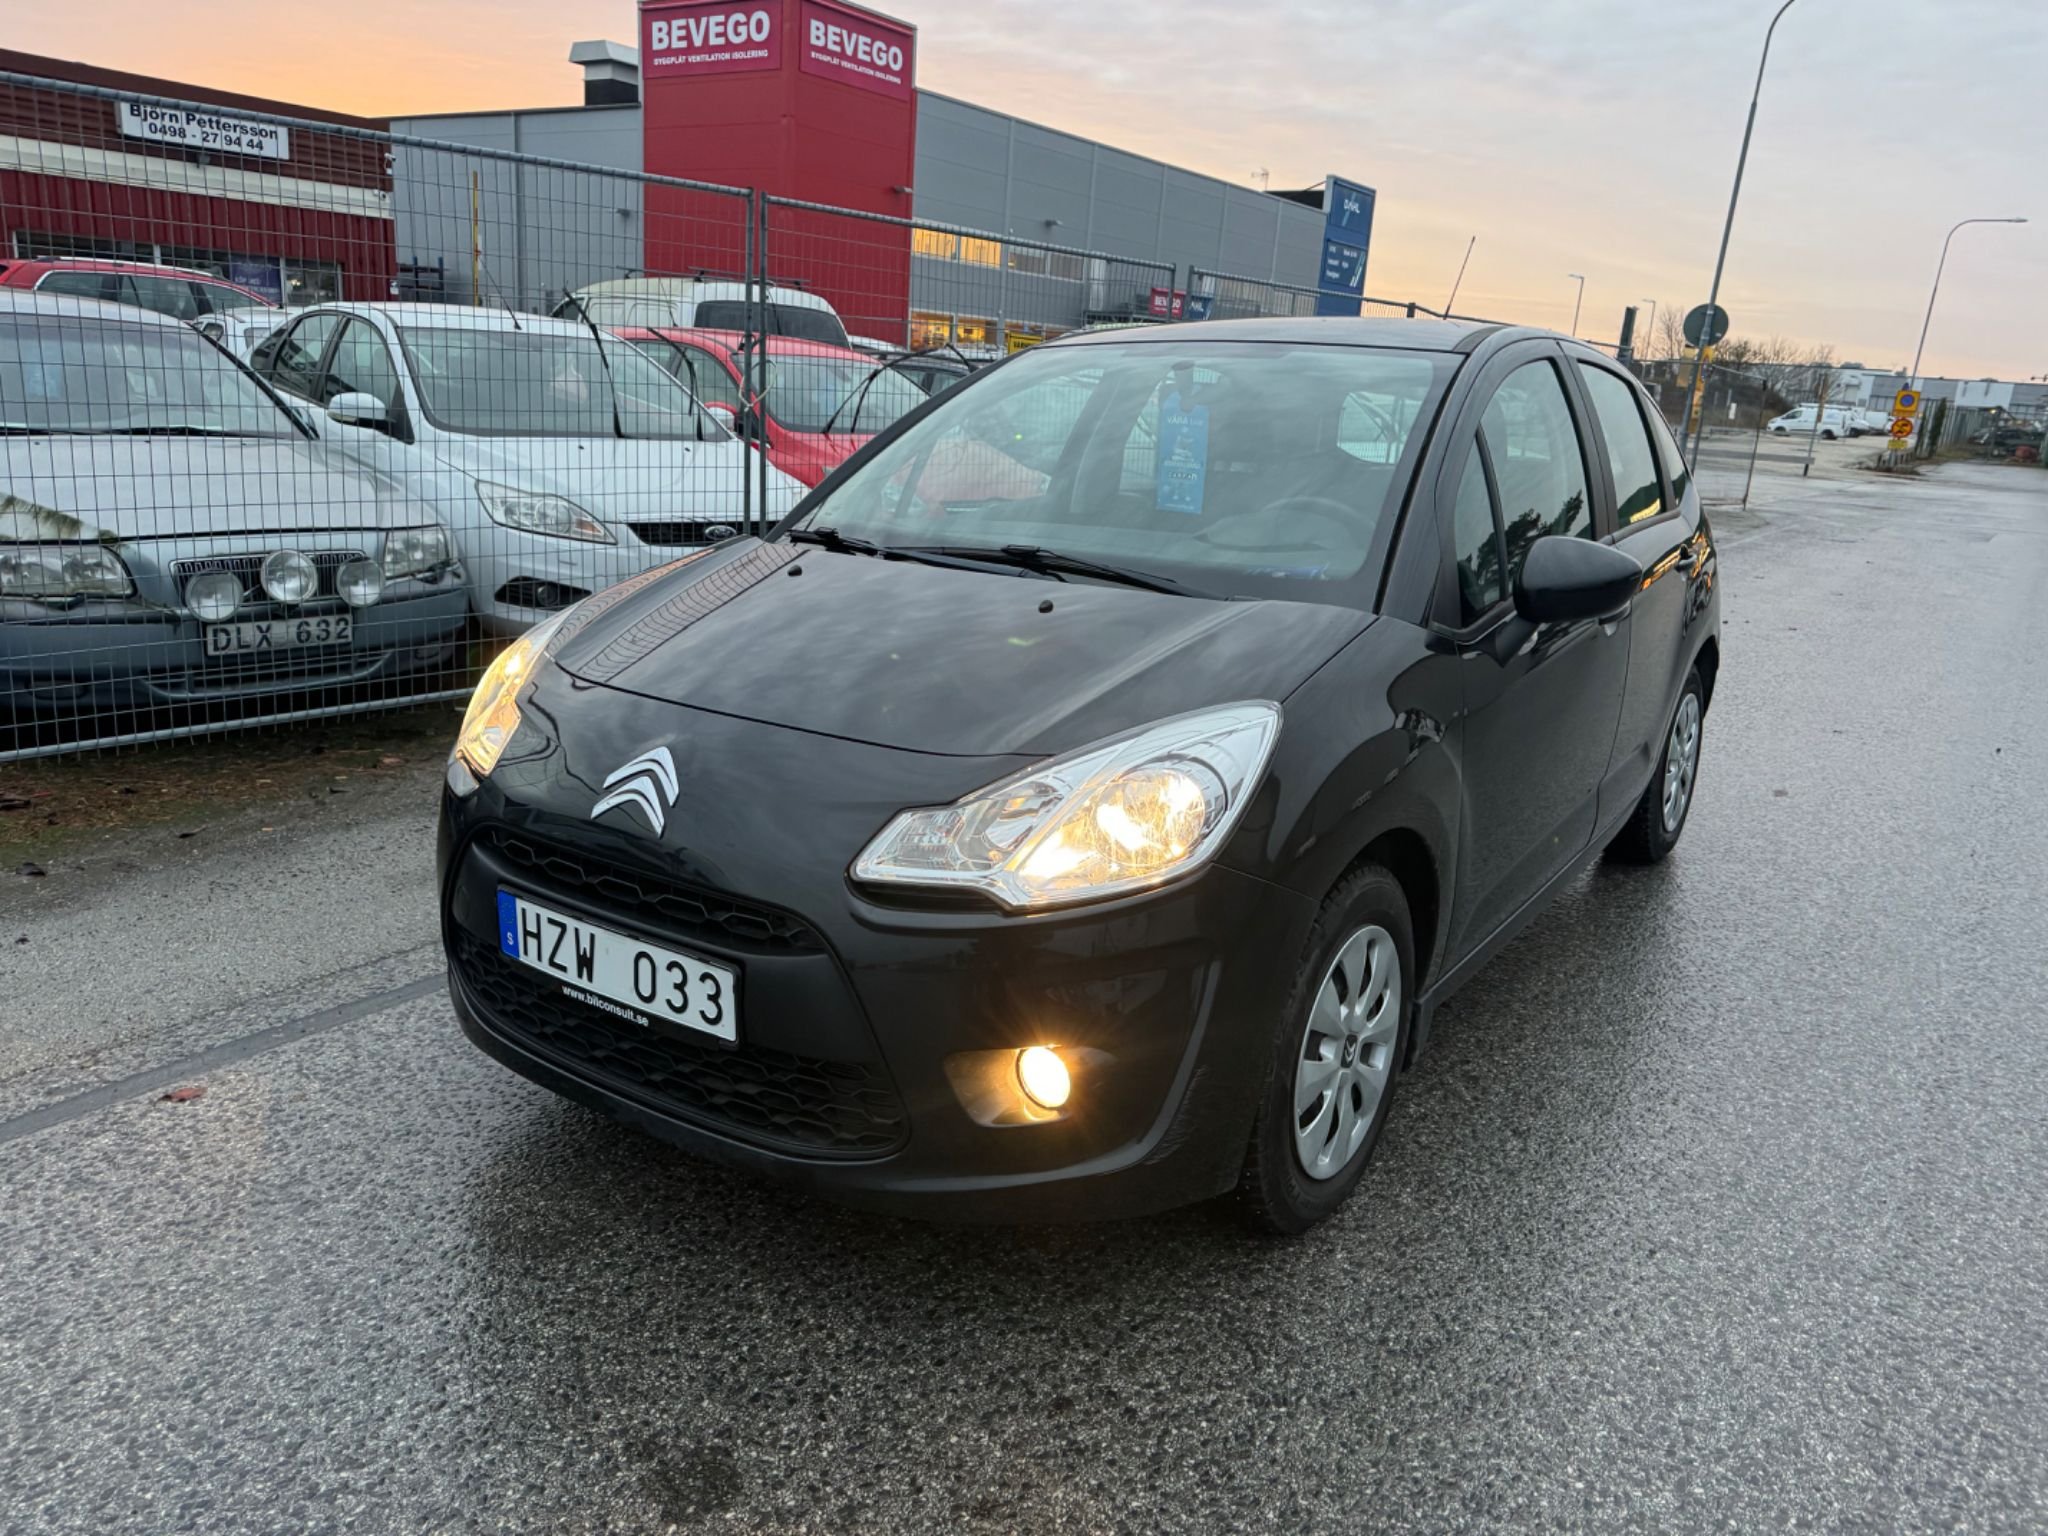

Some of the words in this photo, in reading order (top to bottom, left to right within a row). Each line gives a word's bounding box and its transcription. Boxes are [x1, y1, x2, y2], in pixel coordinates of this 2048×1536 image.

[652, 10, 771, 51] BEVEGO
[809, 18, 903, 71] BEVEGO
[688, 52, 731, 63] VENTILATION
[732, 49, 769, 59] ISOLERING
[129, 103, 180, 122] Björn
[186, 112, 278, 140] Pettersson
[148, 122, 187, 139] 0498
[202, 131, 219, 144] 27
[224, 135, 241, 147] 94
[246, 139, 264, 151] 44
[1155, 295, 1181, 309] BEVGO
[212, 624, 272, 652] DLX
[296, 617, 349, 644] 632
[507, 932, 514, 945] S
[521, 907, 596, 984] HZW
[633, 951, 723, 1026] 033
[562, 985, 649, 1027] www.bilconsult.se
